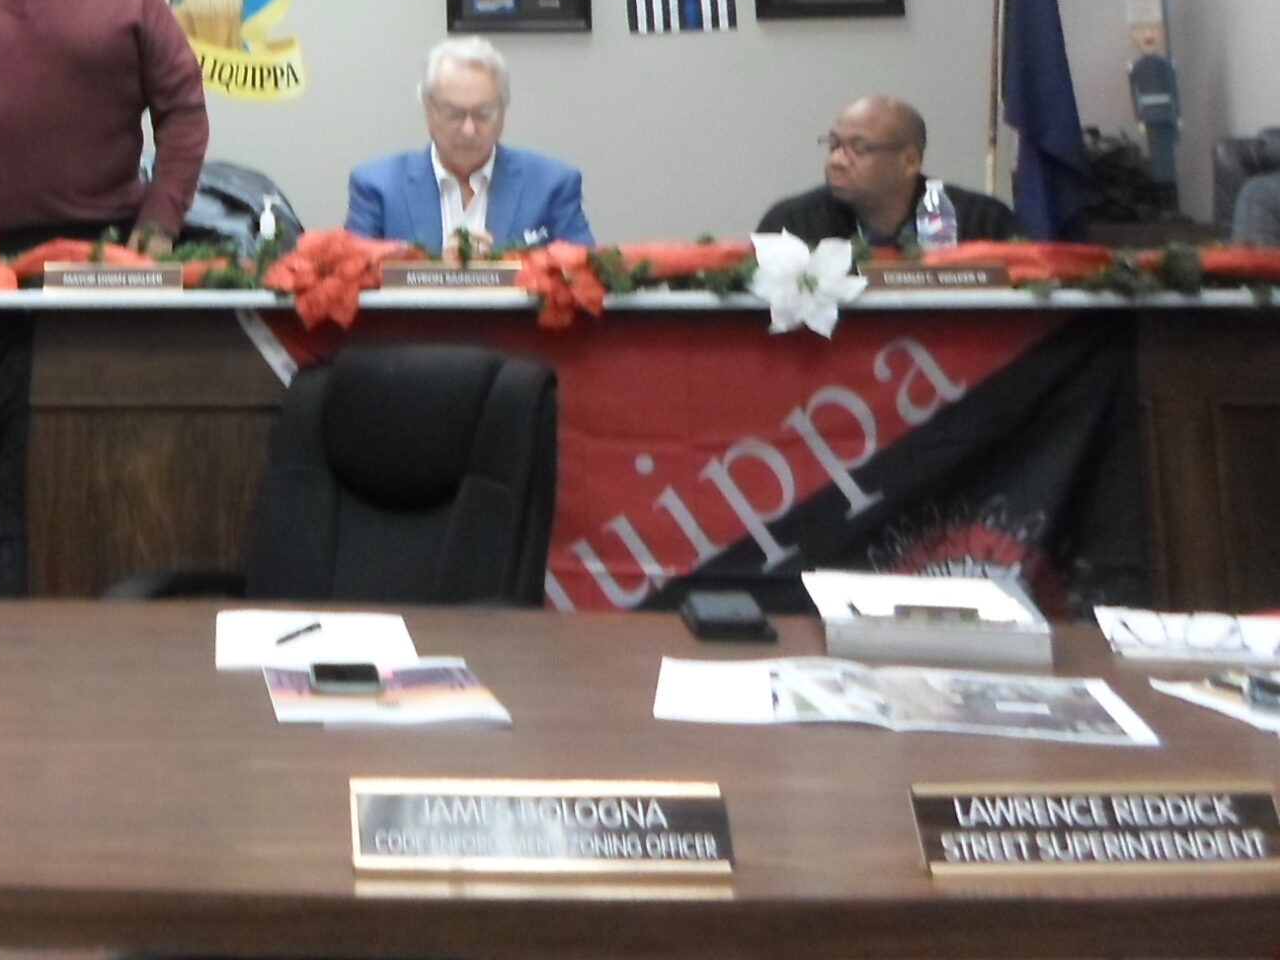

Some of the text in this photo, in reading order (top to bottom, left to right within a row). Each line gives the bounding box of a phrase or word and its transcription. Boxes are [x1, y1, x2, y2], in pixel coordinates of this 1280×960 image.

[198, 54, 300, 92] LIQUIPPA
[545, 336, 966, 612] uippa
[952, 795, 1238, 827] LAWRENCE REDDICK
[645, 831, 718, 860] OFFICER
[940, 829, 1266, 863] STREET SUPERINTENDENT
